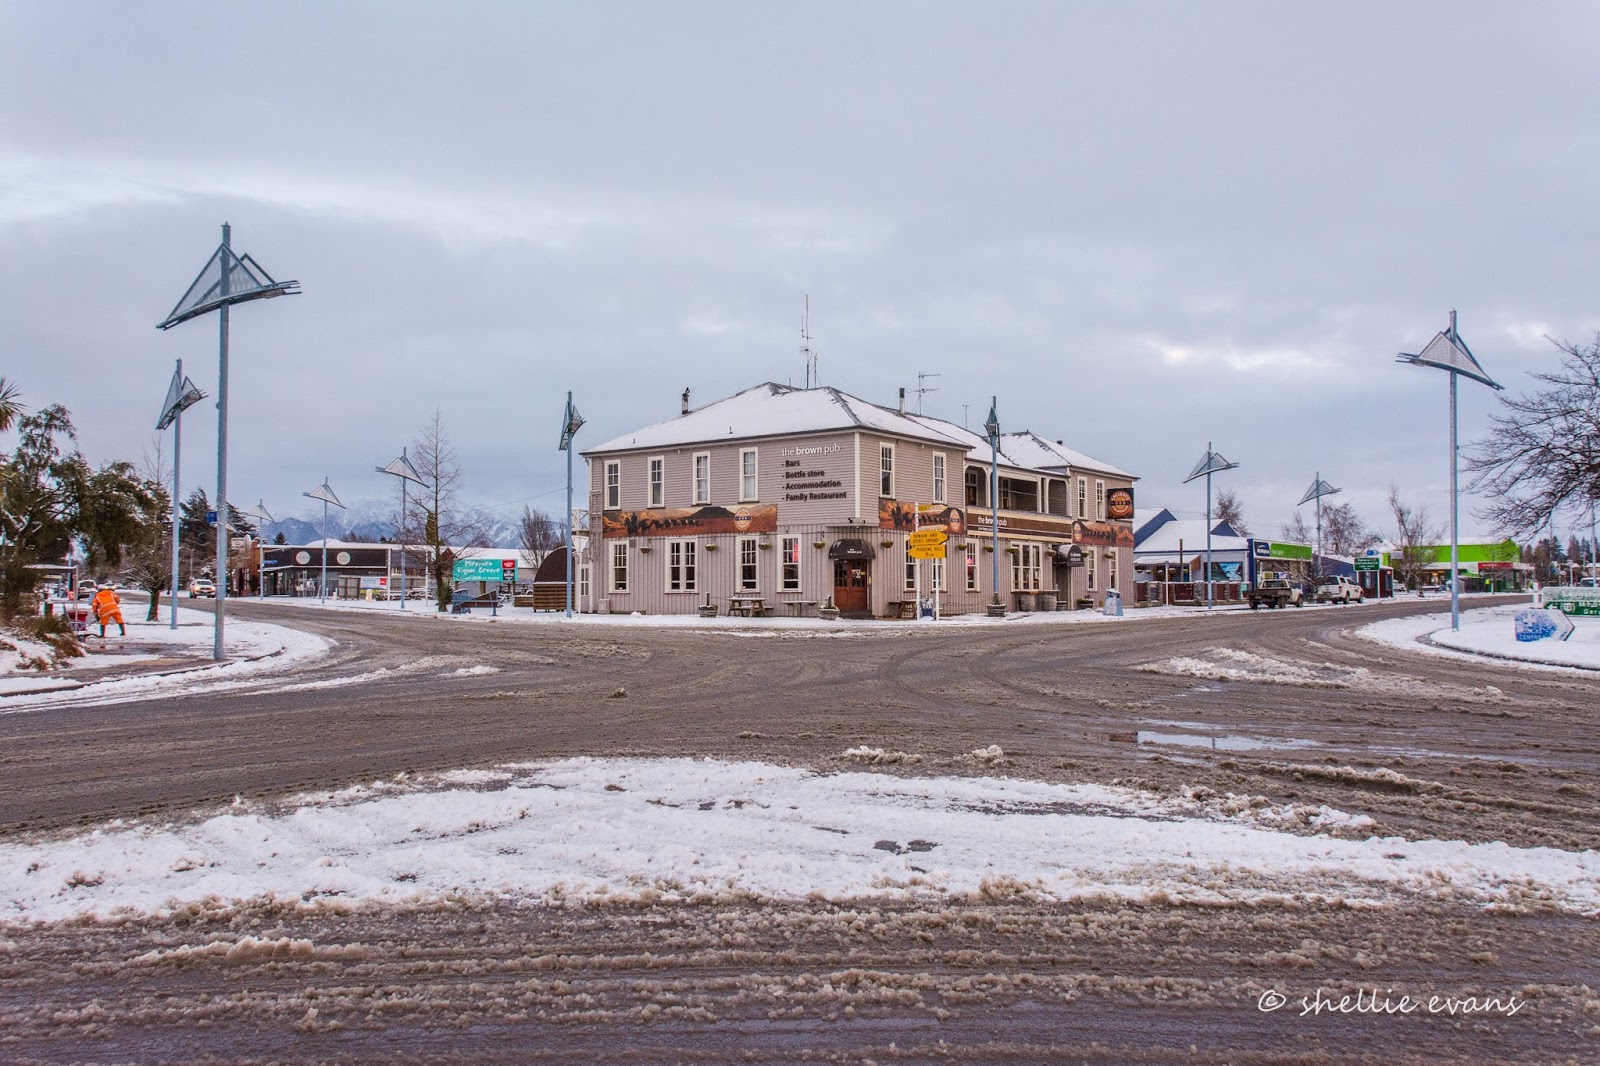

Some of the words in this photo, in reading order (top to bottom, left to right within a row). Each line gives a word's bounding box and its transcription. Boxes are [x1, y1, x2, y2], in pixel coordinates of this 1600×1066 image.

[782, 448, 794, 456] the
[796, 446, 822, 455] brown
[824, 443, 840, 455] pub
[785, 471, 806, 479] Bottle
[807, 470, 825, 478] store
[785, 480, 841, 490] Accommodation
[785, 493, 807, 502] Family
[809, 491, 846, 500] Restaurant
[999, 518, 1007, 526] pub
